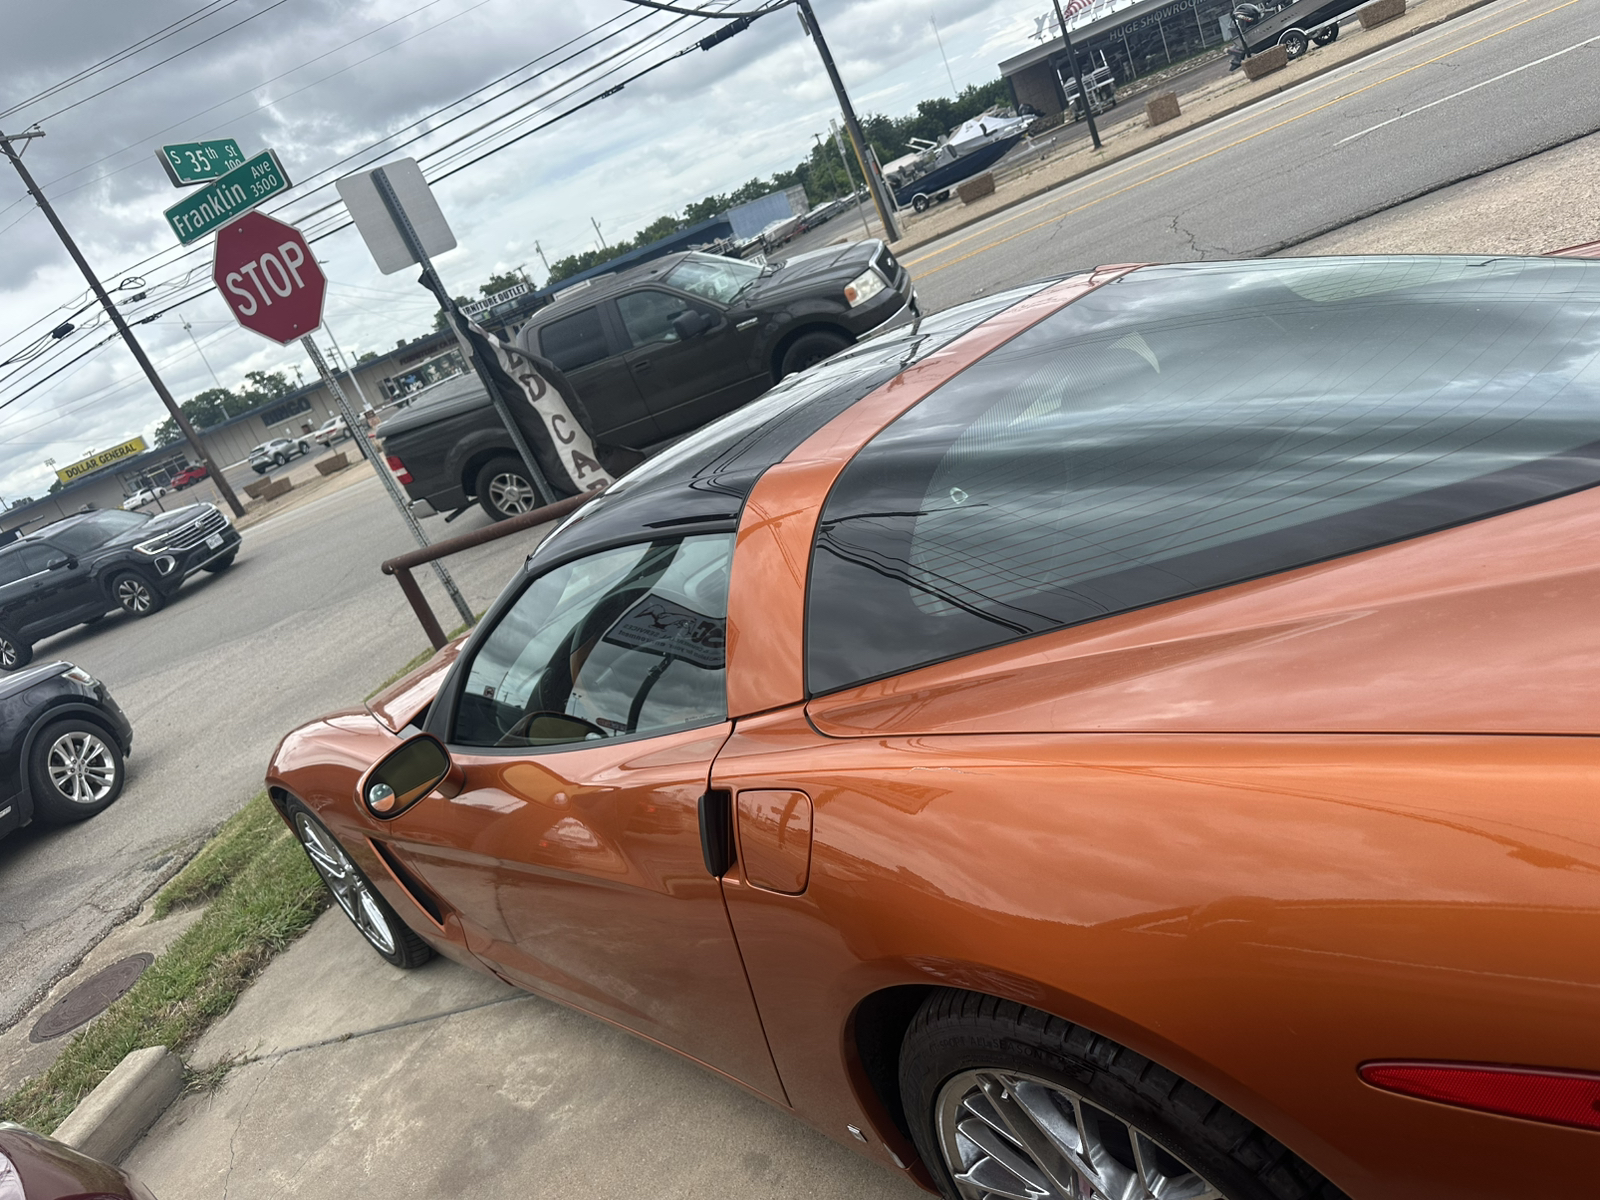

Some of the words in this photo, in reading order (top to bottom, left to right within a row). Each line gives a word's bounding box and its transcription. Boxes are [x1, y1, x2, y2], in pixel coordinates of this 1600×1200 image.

[1109, 20, 1139, 41] HUGE
[170, 151, 181, 164] S
[185, 147, 218, 172] 35th
[225, 144, 237, 157] St
[172, 181, 248, 237] Franklin
[251, 159, 272, 180] Ave
[250, 174, 278, 198] 3500
[225, 240, 305, 317] STOP
[499, 284, 526, 303] OUTLET
[65, 457, 99, 479] DOLLAR
[99, 443, 137, 465] GENERAL
[992, 1037, 1043, 1060] SEASON
